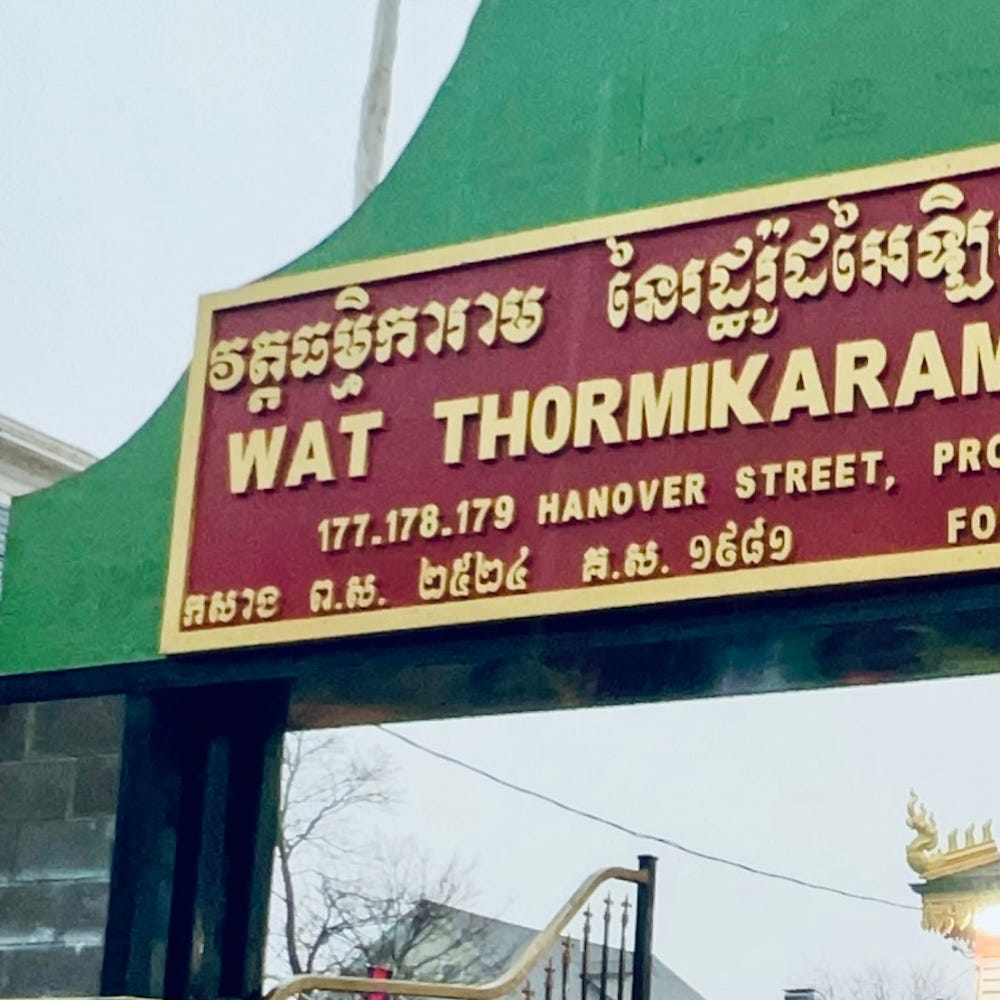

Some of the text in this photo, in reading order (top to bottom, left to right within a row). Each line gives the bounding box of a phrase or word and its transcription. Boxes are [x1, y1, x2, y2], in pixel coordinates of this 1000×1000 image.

[228, 410, 384, 494] WAT
[317, 494, 515, 552] 177.178.179
[537, 473, 705, 525] HANOVER
[735, 450, 895, 500] STREET,
